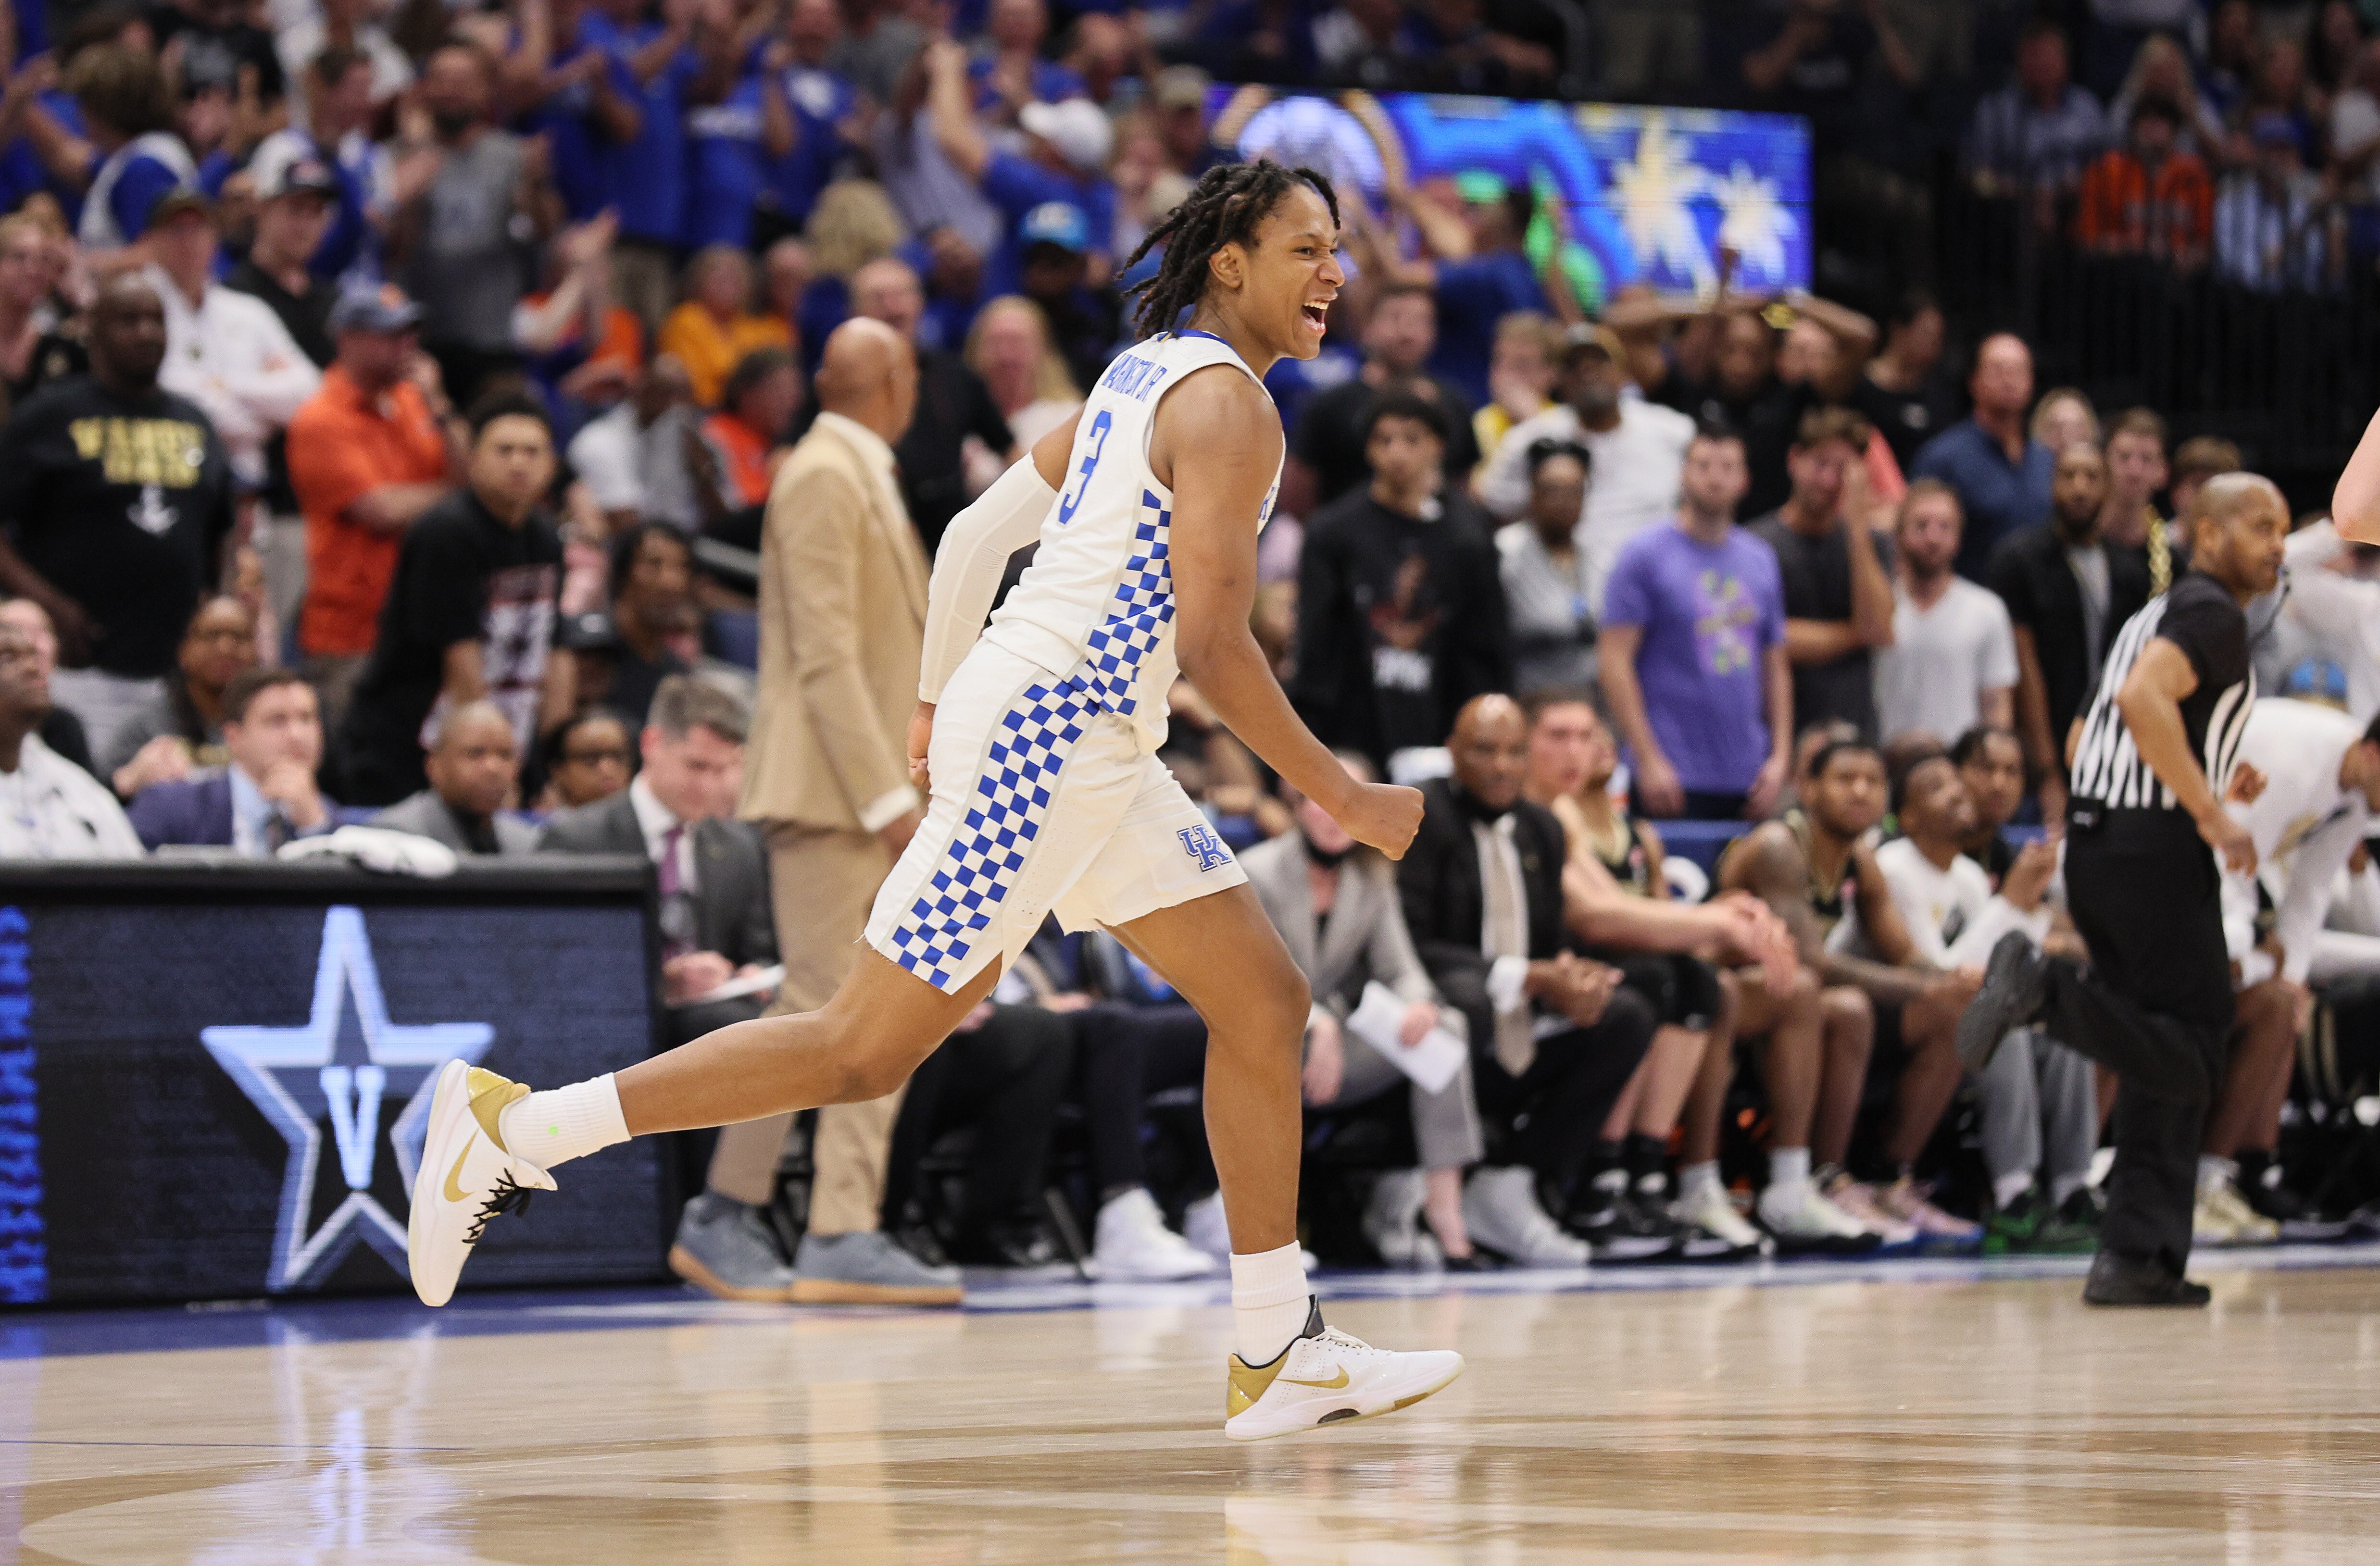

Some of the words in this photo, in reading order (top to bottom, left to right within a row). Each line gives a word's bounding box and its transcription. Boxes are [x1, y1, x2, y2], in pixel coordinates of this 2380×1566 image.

[1058, 409, 1112, 526] 3
[1177, 824, 1232, 872] UK
[319, 1065, 386, 1189] V
